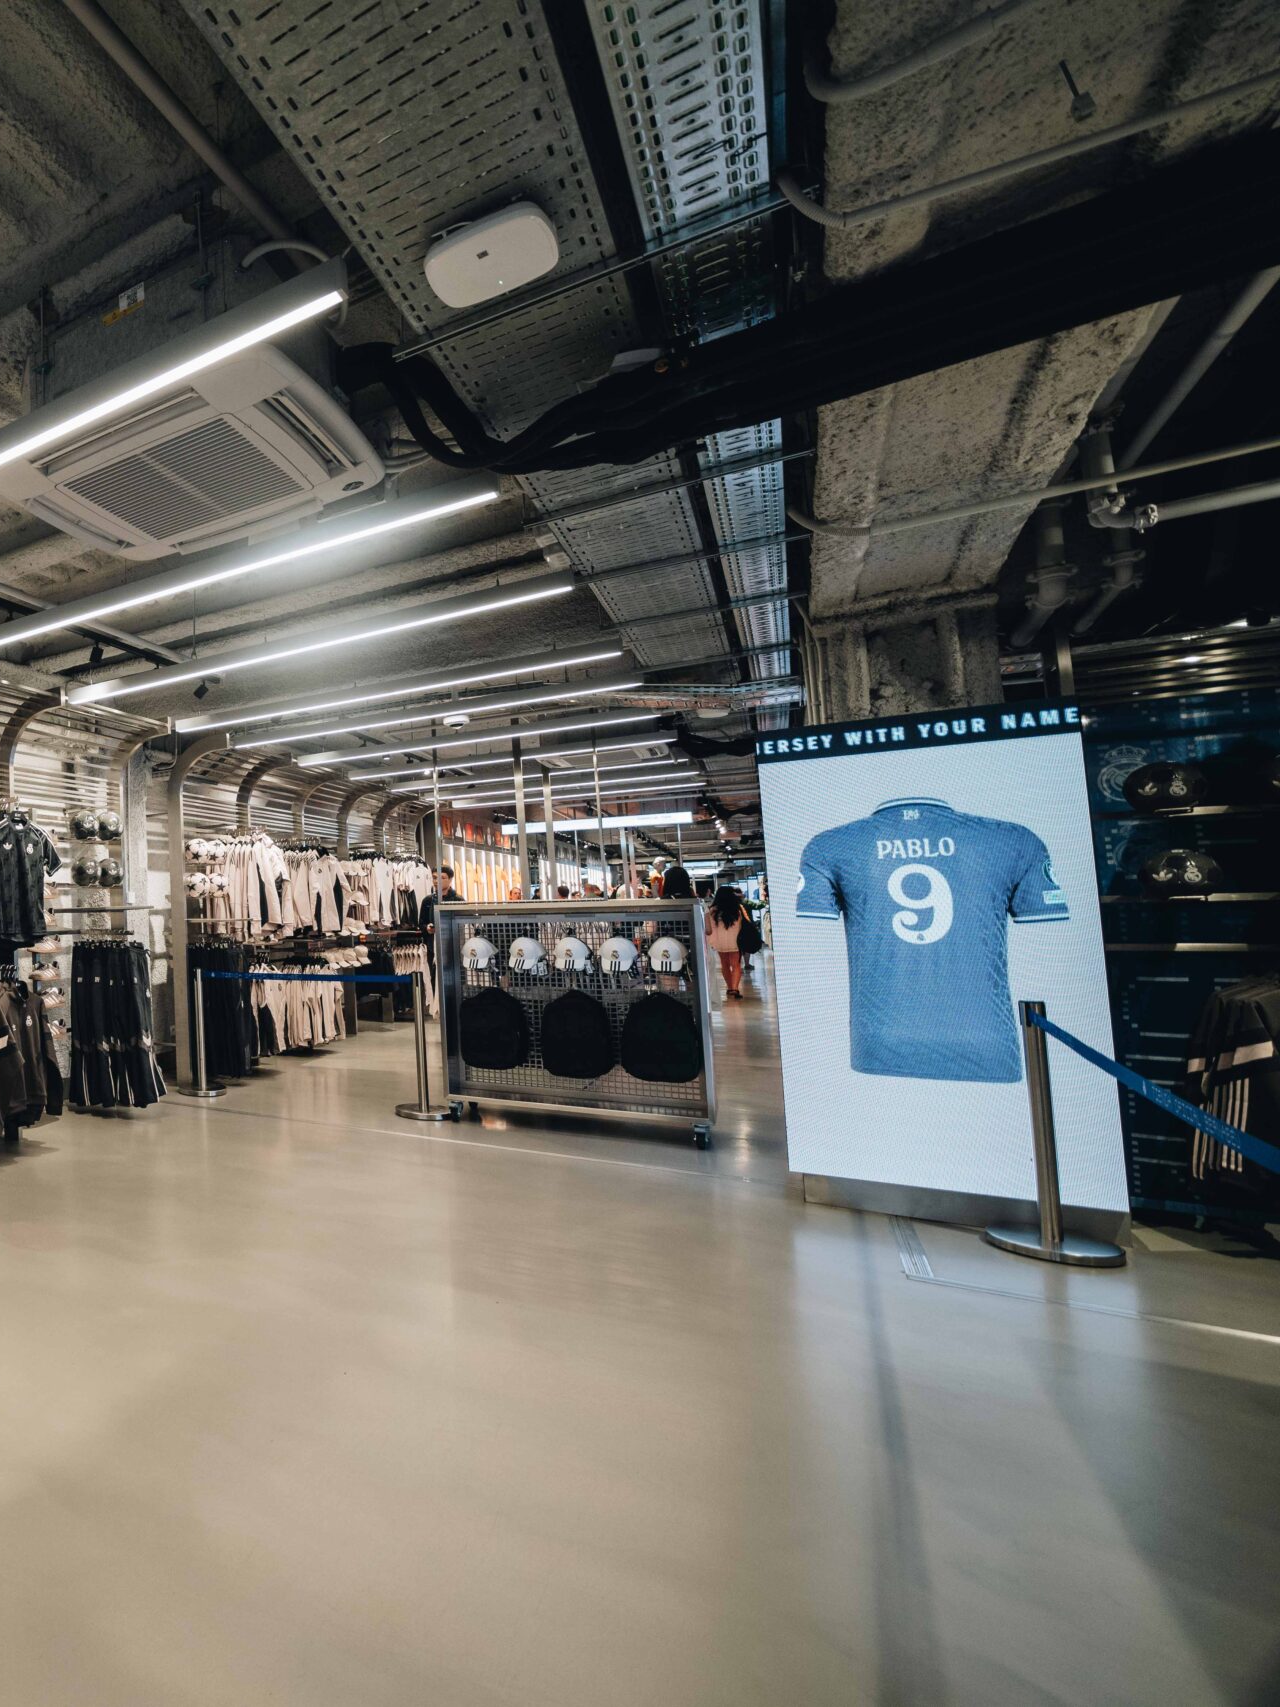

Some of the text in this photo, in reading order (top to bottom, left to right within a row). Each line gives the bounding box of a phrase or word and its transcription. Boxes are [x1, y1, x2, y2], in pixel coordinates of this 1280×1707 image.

[843, 726, 906, 746] WITH
[917, 717, 987, 738] YOUR
[1001, 707, 1080, 729] NAME
[876, 837, 955, 860] PABLO
[887, 863, 954, 945] 9
